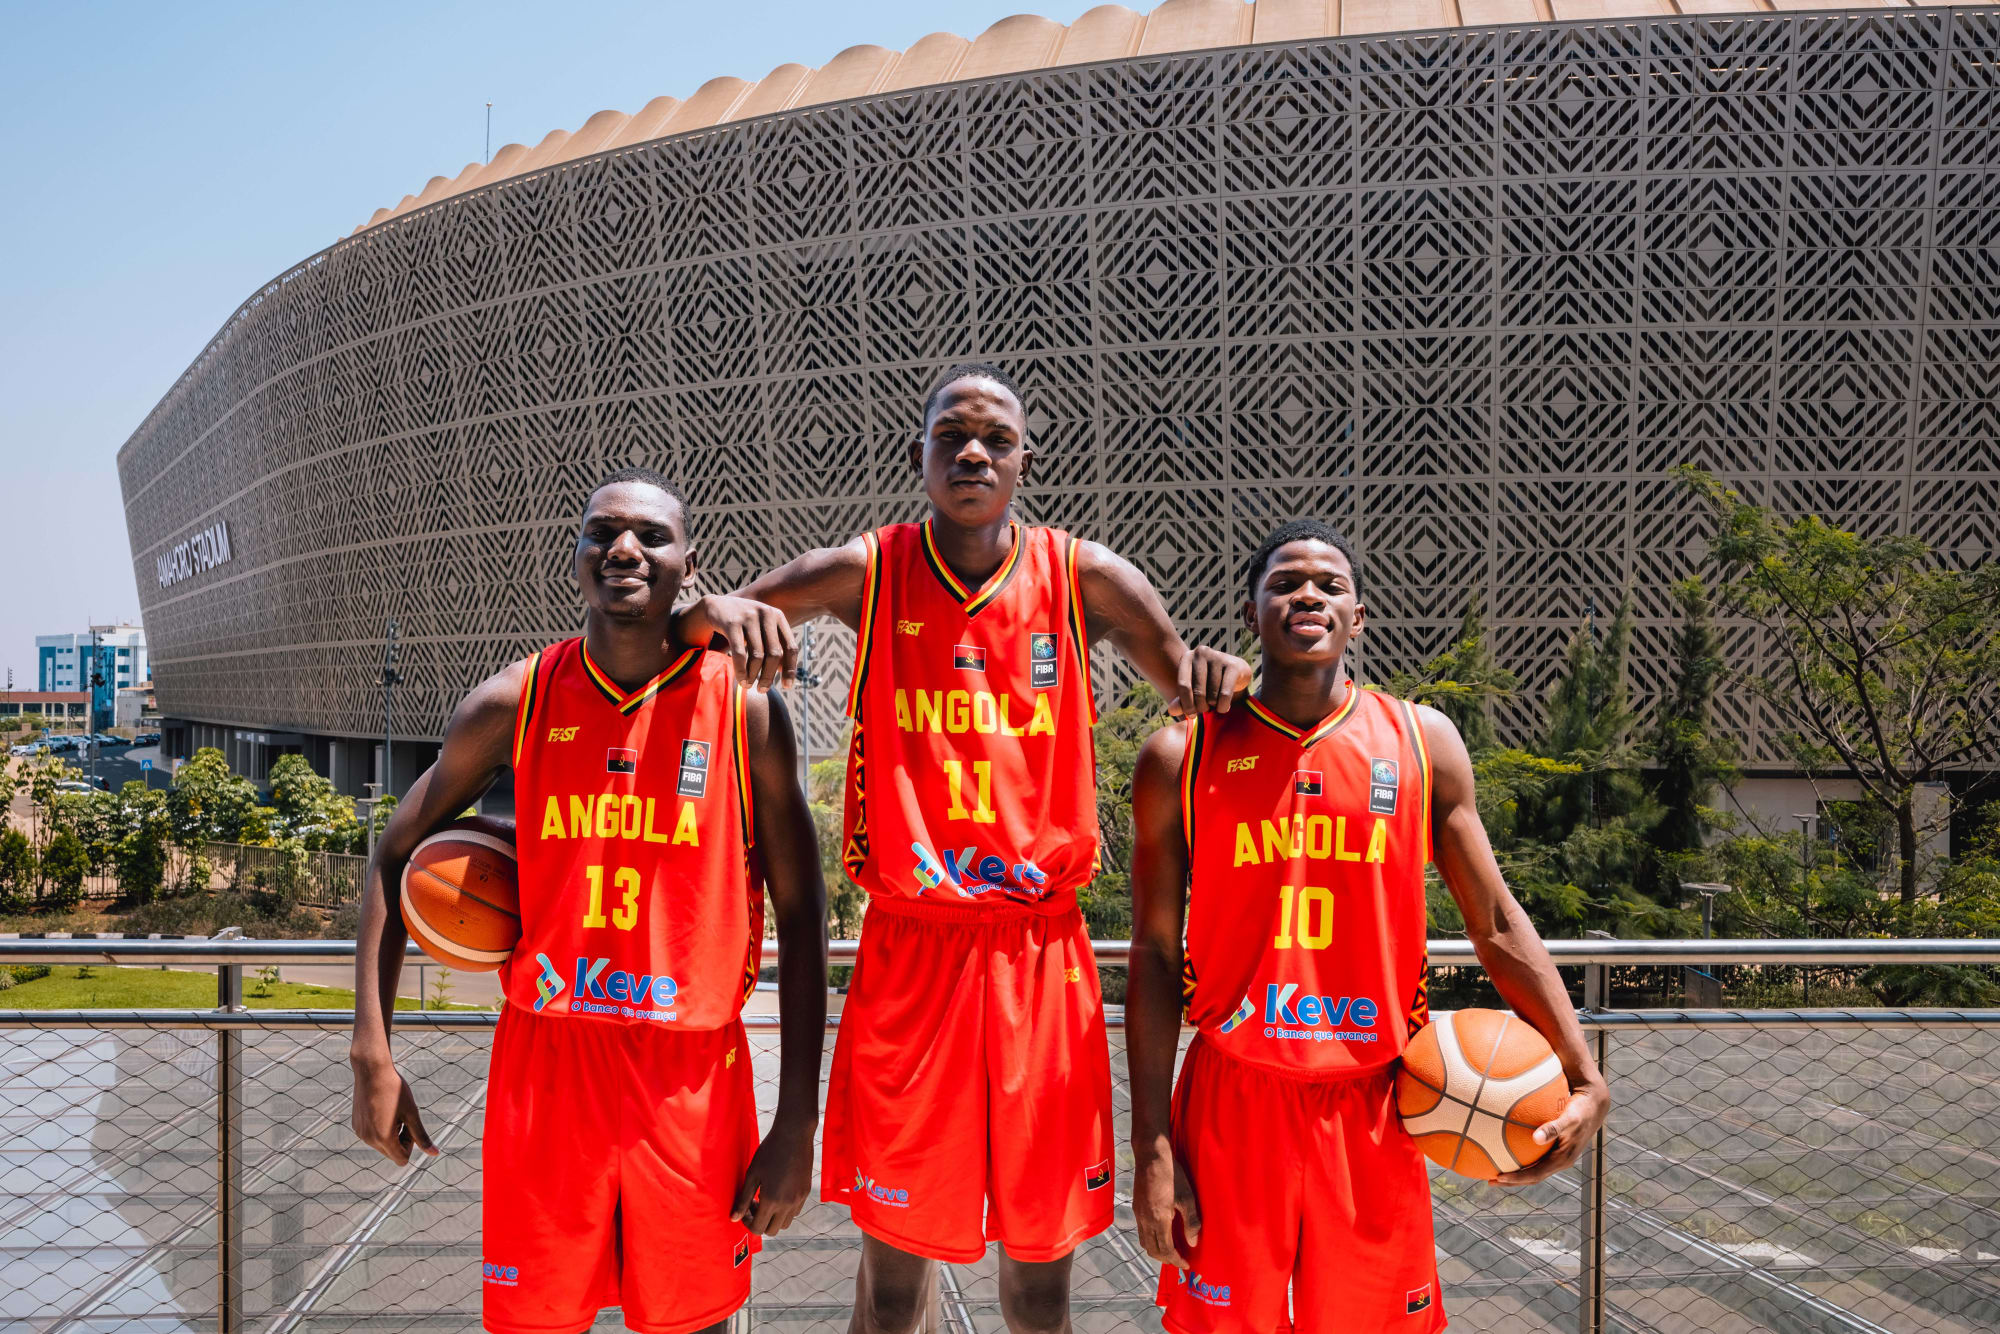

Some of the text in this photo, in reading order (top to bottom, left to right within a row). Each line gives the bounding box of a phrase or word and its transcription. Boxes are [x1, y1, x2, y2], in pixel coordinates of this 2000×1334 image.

[157, 520, 231, 589] AMAHORO STADIUM
[1035, 663, 1054, 674] FIBA
[895, 688, 1056, 737] ANGOLA
[548, 726, 581, 742] FAST
[682, 771, 703, 783] FIBA
[1227, 755, 1260, 773] FAST
[943, 759, 996, 824] 11
[1374, 788, 1394, 800] FIBA
[540, 793, 700, 847] ANGOLA
[1233, 813, 1387, 868] ANGOLA
[582, 865, 641, 931] 13
[1274, 885, 1335, 950] 10
[574, 957, 678, 1007] Keve
[571, 1001, 581, 1012] O
[583, 1001, 619, 1014] Banco
[636, 1009, 677, 1022] avança
[1264, 983, 1378, 1027] Keve
[1264, 1027, 1378, 1043] O Banco que avança
[865, 1175, 908, 1202] Keve
[483, 1262, 519, 1280] eve
[1188, 1271, 1231, 1300] Keve
